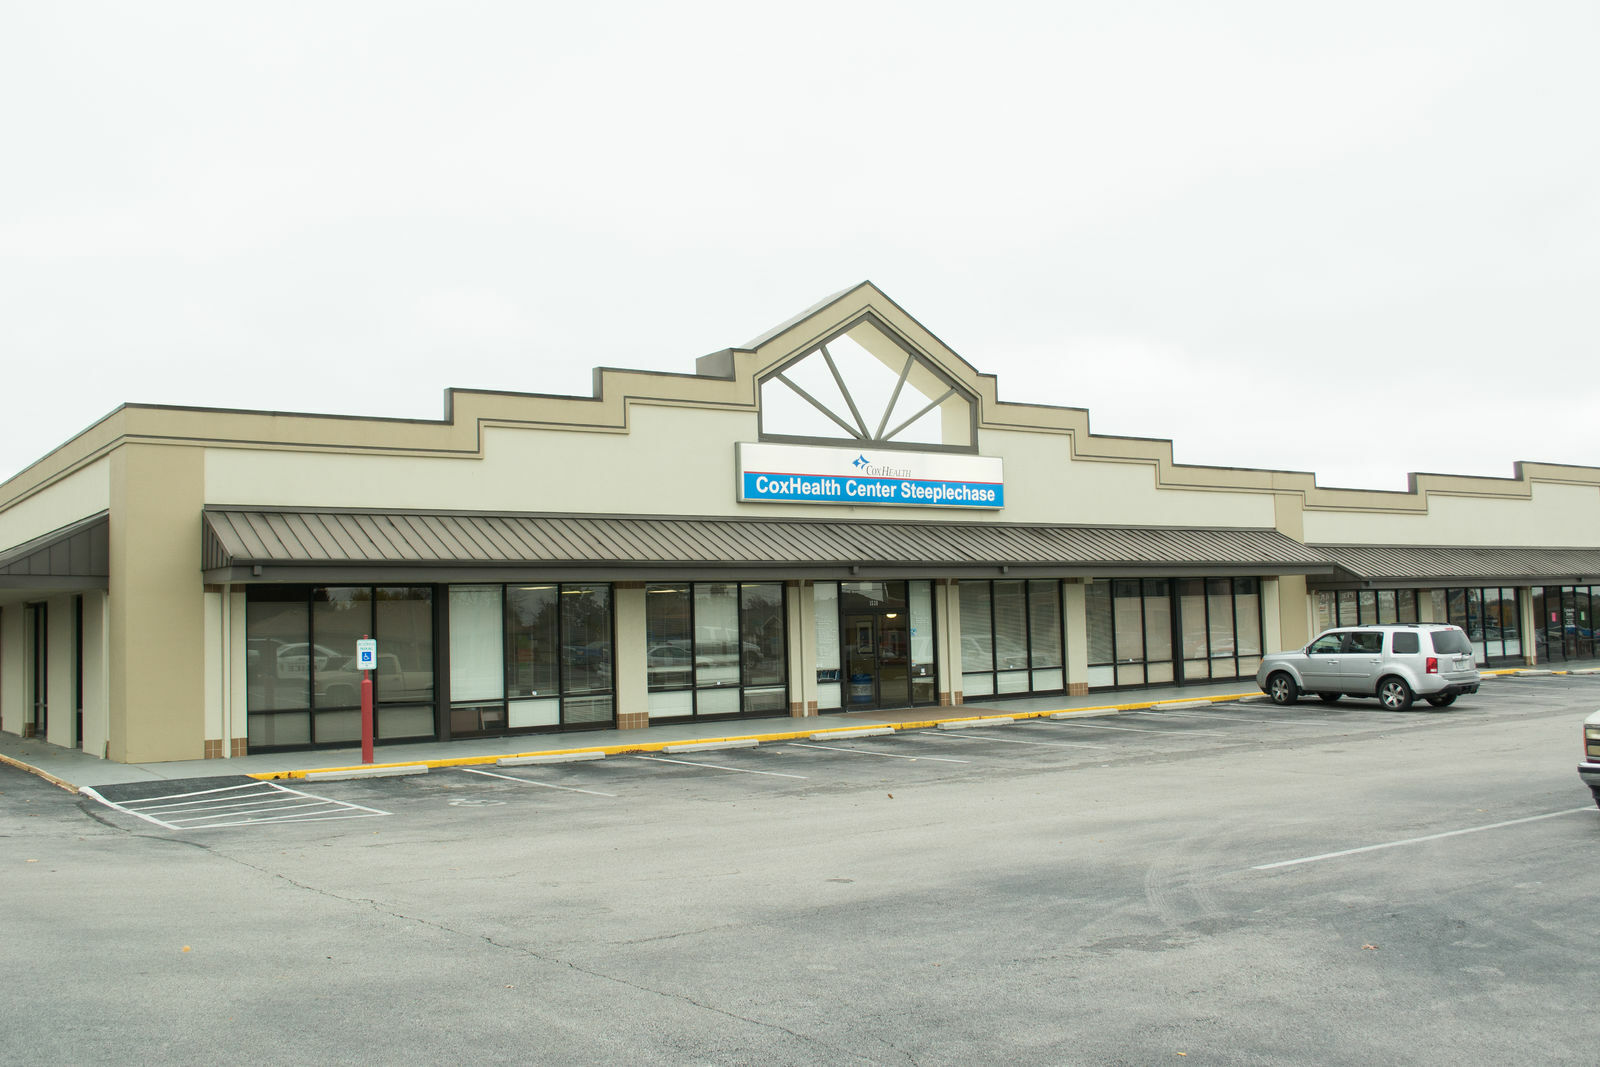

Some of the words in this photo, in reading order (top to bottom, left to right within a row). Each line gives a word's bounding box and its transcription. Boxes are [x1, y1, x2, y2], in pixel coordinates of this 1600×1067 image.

[756, 475, 841, 496] CoxHealth
[845, 479, 897, 498] Center
[901, 481, 996, 503] Steeplechase
